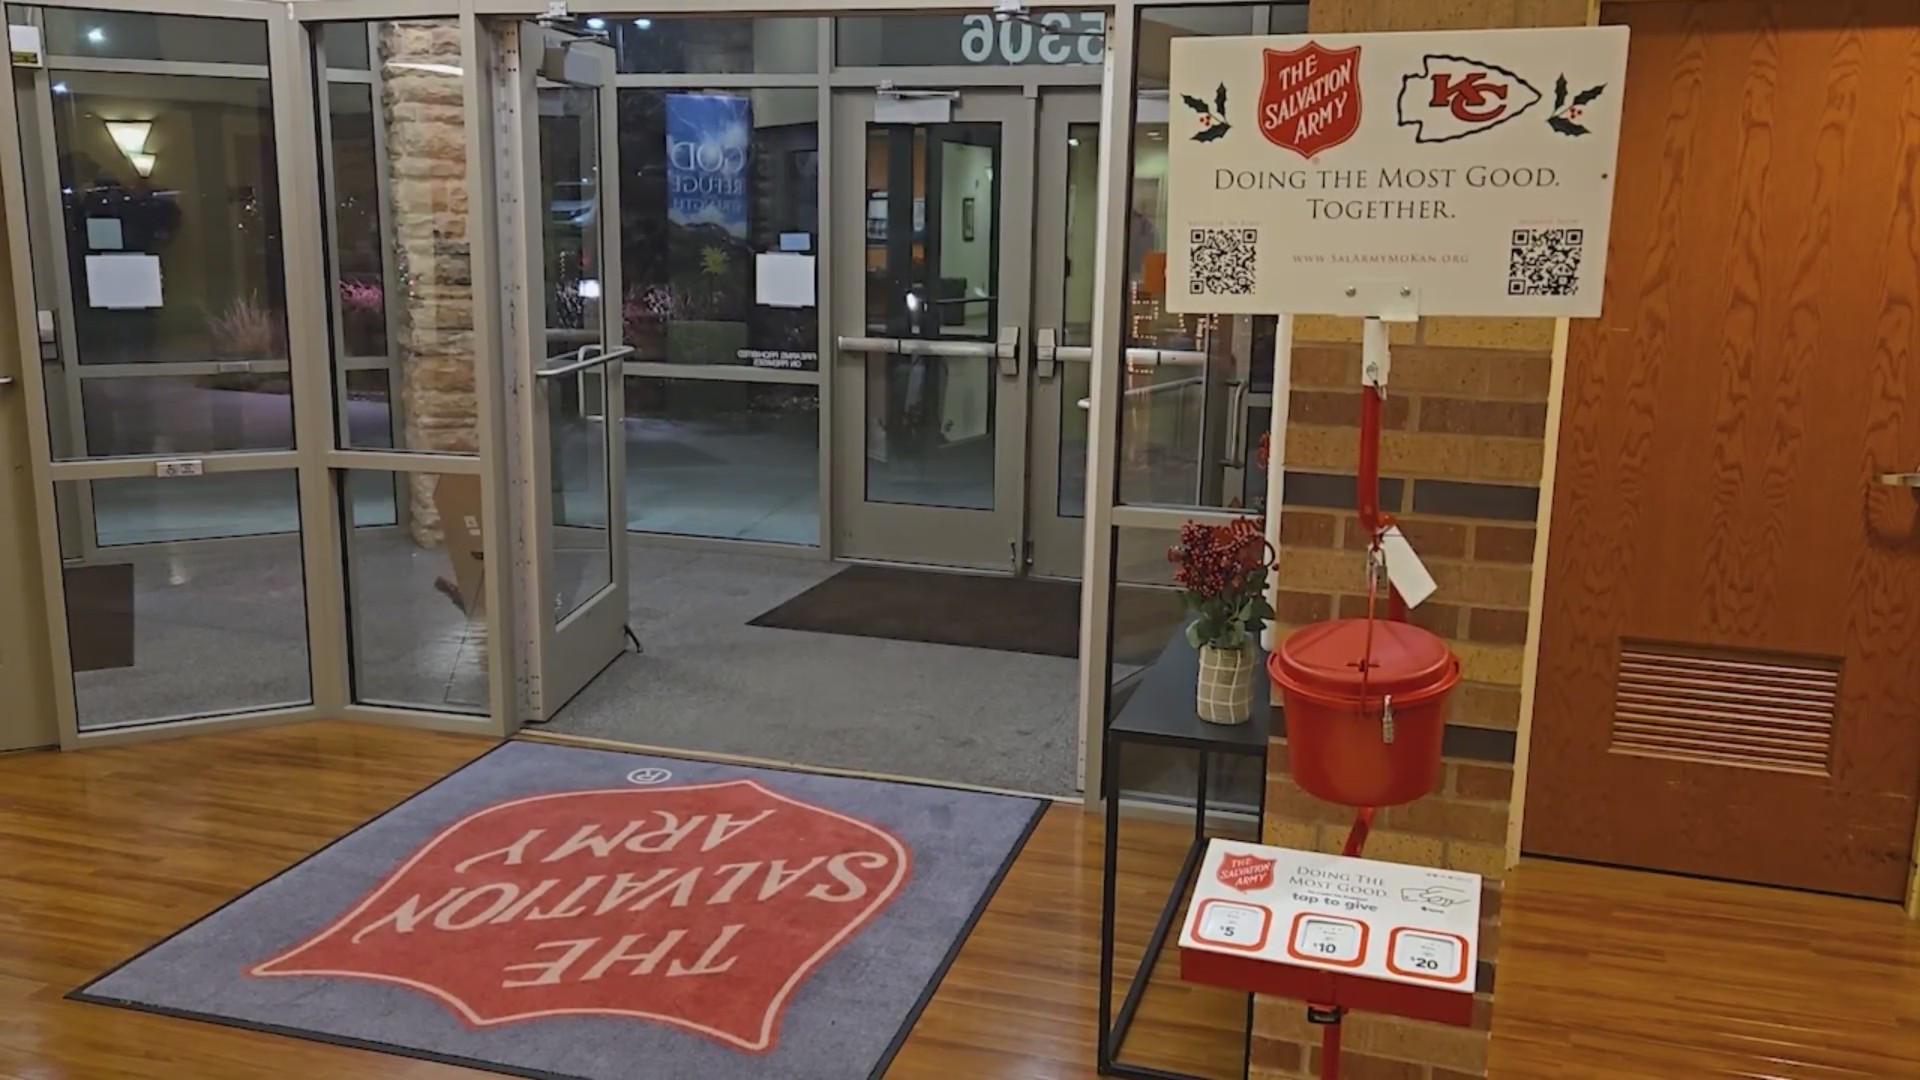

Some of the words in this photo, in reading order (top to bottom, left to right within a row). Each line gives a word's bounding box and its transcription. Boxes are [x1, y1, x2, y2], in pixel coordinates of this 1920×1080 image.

[1280, 54, 1318, 91] THE
[1265, 58, 1351, 130] SALVATION
[1429, 72, 1508, 122] KC
[1294, 91, 1348, 144] ARMY
[1215, 168, 1306, 190] DOING
[1316, 170, 1368, 189] THE
[1378, 168, 1456, 189] MOST
[1466, 165, 1560, 188] GOOD.
[1306, 198, 1456, 220] TOGETHER.
[455, 809, 777, 874] ARMY
[1220, 861, 1271, 880] SALVATION
[1232, 857, 1253, 868] THE
[1235, 872, 1268, 886] ARMY
[1289, 875, 1334, 890] MOST
[1297, 866, 1350, 881] DOING
[1356, 874, 1384, 886] THE
[352, 851, 889, 944] SALVATION
[1292, 892, 1319, 904] tap
[1324, 897, 1340, 906] to
[1345, 900, 1378, 912] give
[502, 923, 745, 988] THE
